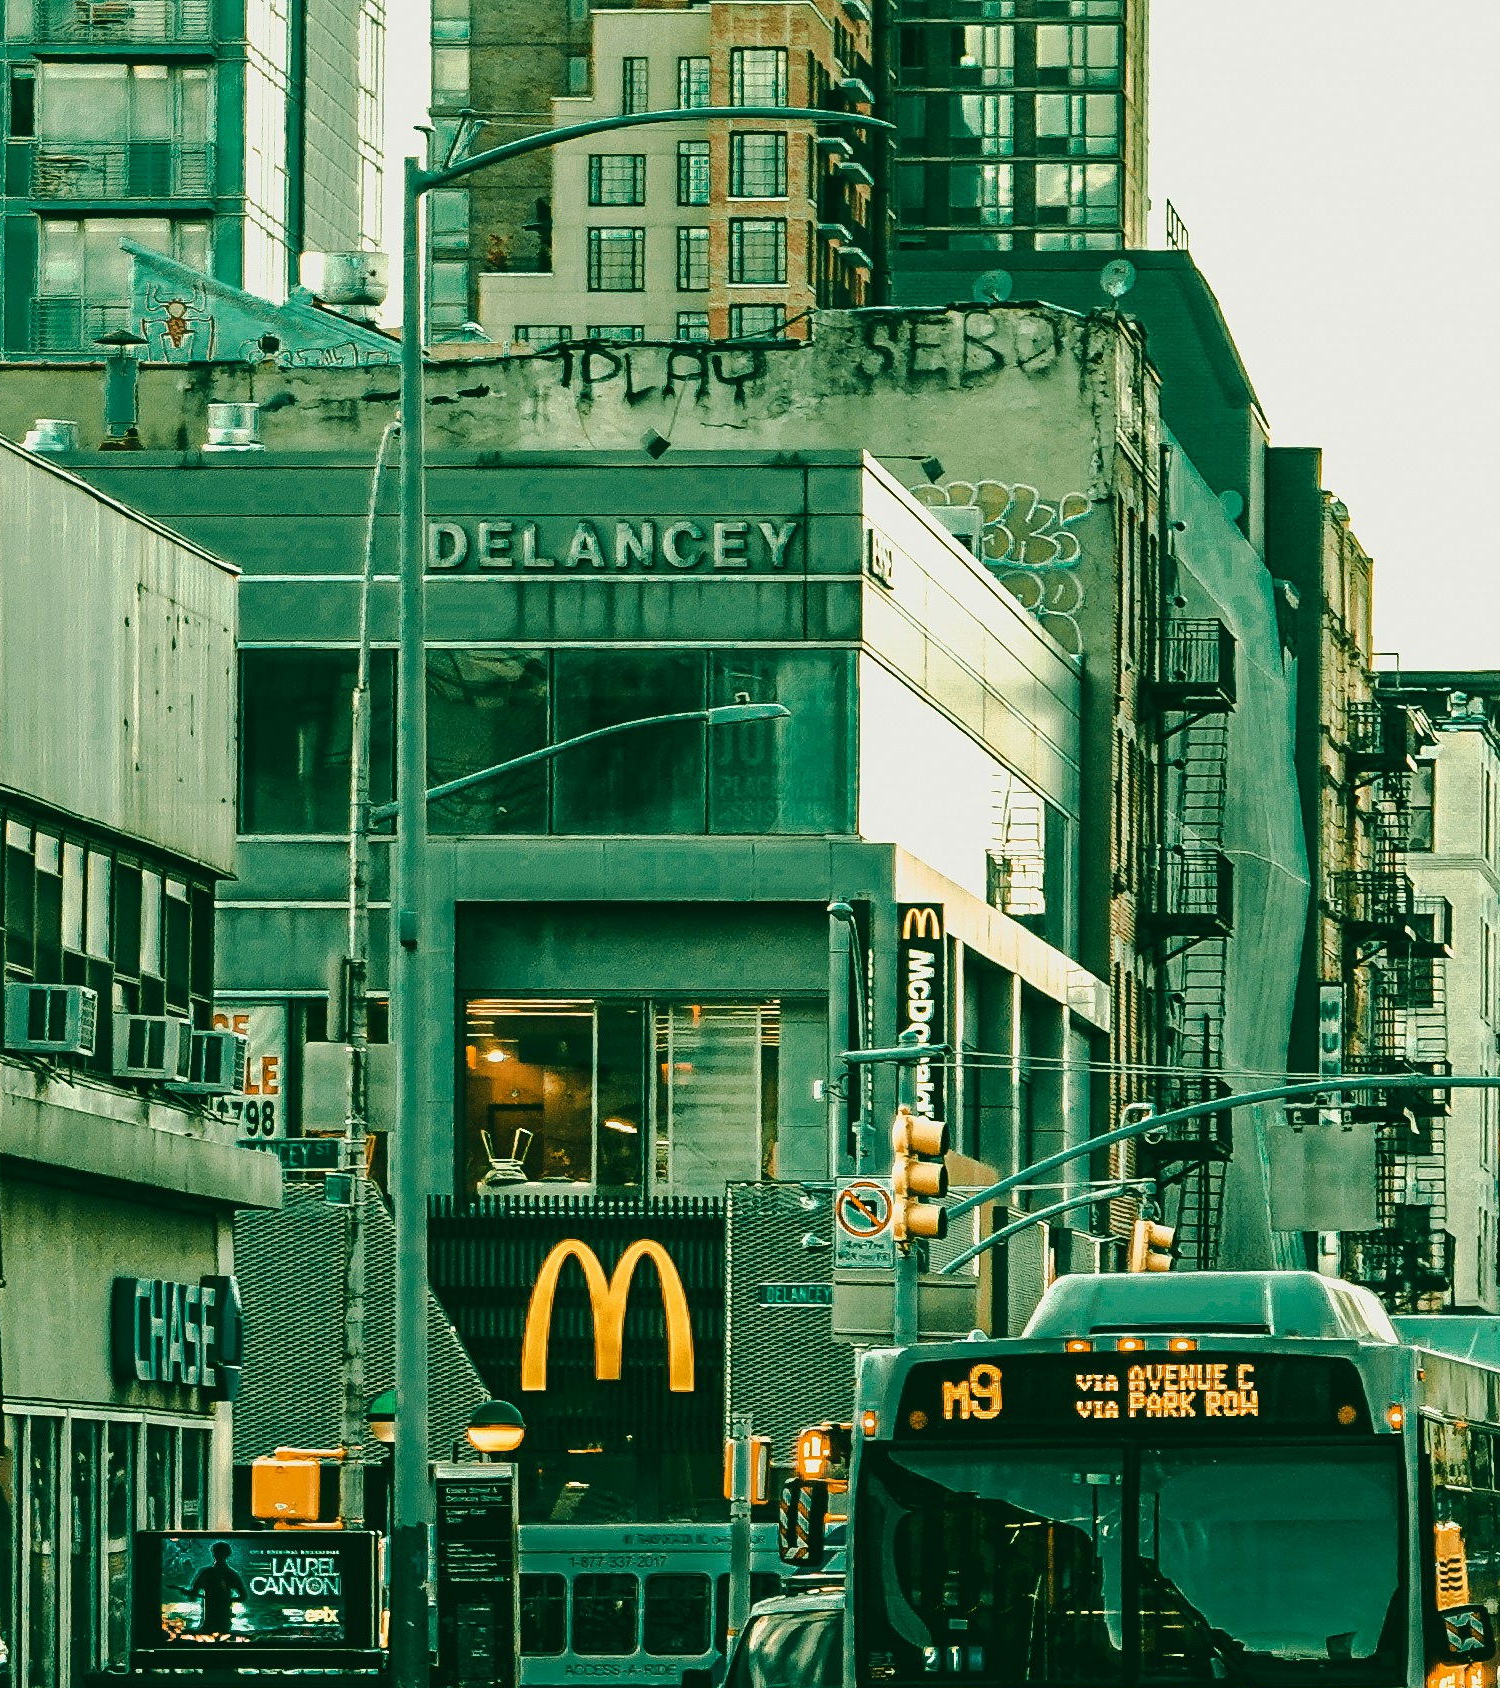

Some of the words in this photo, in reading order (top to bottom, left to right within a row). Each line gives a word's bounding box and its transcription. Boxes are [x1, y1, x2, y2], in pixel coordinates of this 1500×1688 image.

[427, 520, 798, 569] DELANCEY
[766, 1286, 831, 1303] DELANCEY
[134, 1278, 216, 1387] CHASE
[1075, 1374, 1119, 1391] VIA
[1129, 1363, 1228, 1391] AVENUE
[1237, 1363, 1255, 1391] C
[1075, 1400, 1120, 1418] VIA
[1129, 1391, 1196, 1418] PARK
[1205, 1391, 1258, 1417] ROW
[272, 1557, 341, 1577] LAUREL
[569, 1555, 668, 1568] 1-877-337-2017
[250, 1577, 342, 1596] CANYON
[564, 1664, 678, 1677] ACCESS-A-RIDE
